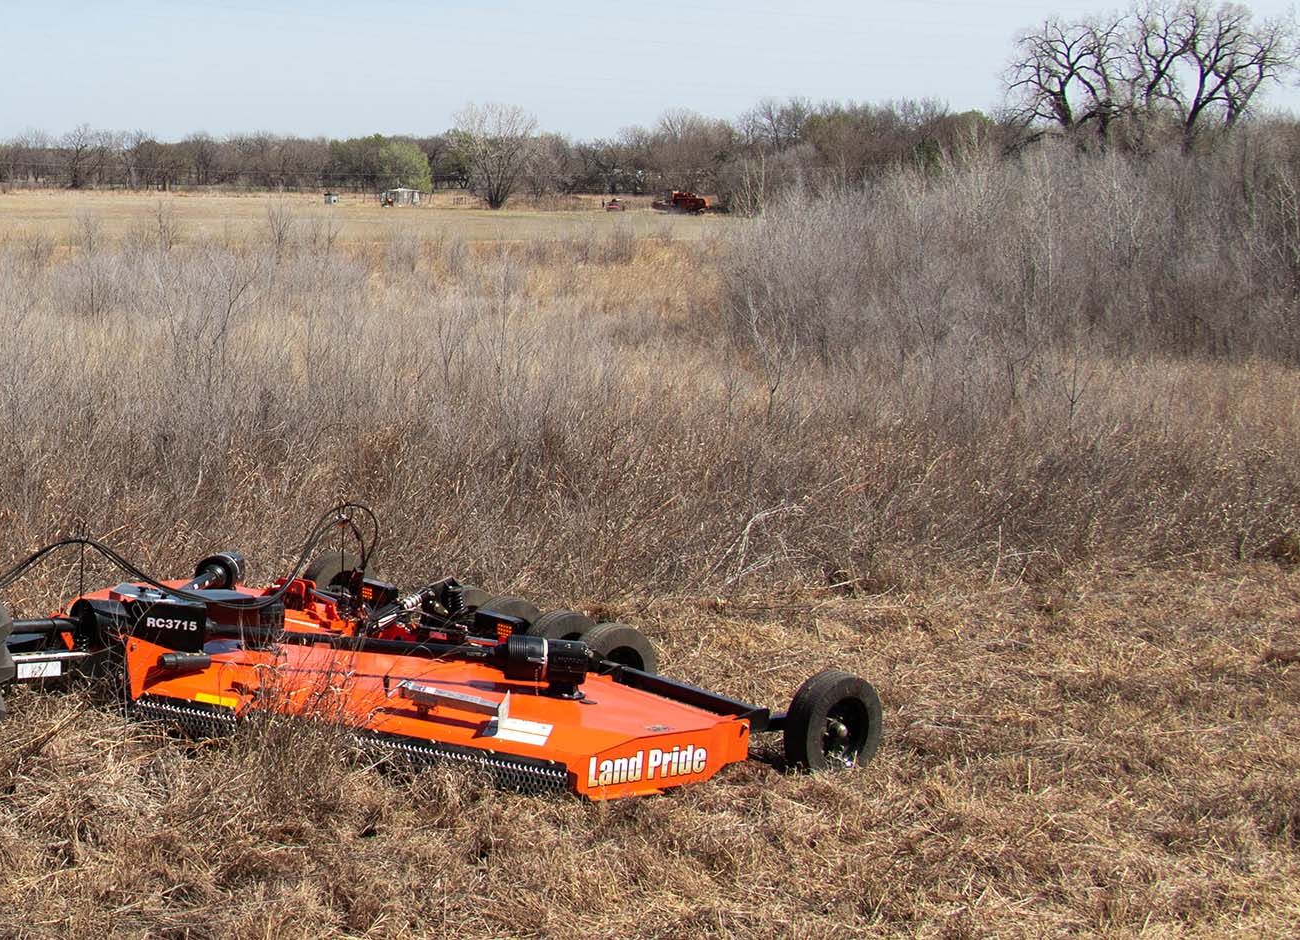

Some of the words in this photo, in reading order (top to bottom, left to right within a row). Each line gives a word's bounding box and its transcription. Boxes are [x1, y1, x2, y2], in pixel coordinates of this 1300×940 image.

[146, 616, 198, 631] RC3715
[587, 750, 644, 788] Land
[646, 744, 707, 780] Pride
